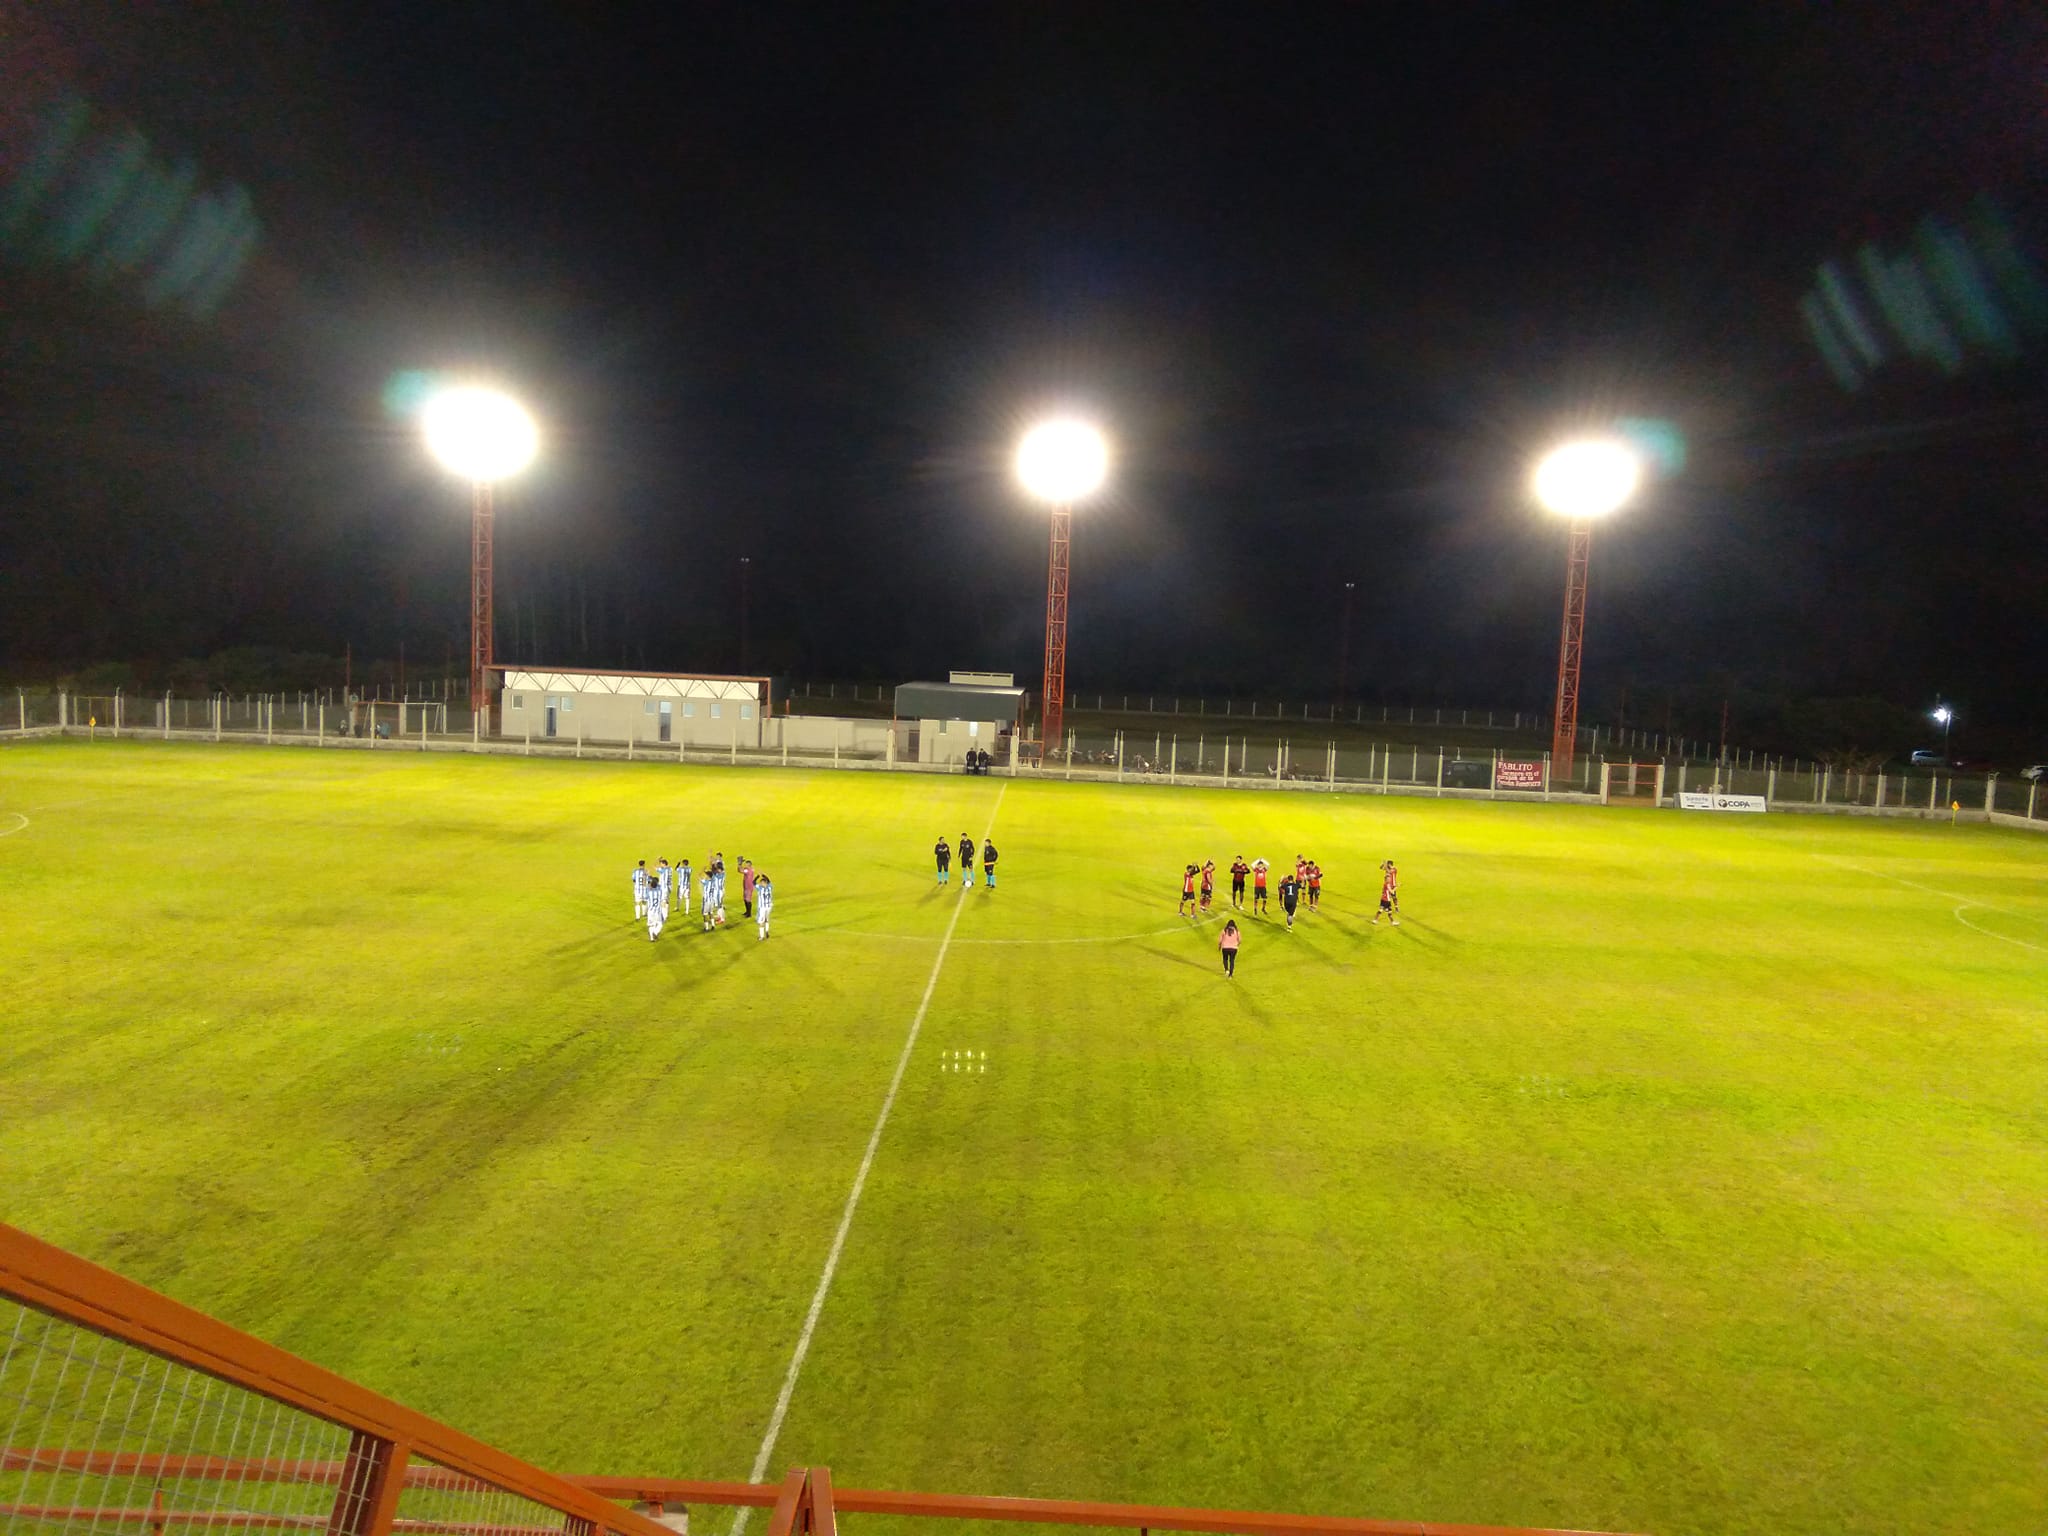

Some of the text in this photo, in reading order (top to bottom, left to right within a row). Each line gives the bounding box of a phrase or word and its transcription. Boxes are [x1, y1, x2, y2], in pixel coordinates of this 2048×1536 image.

[1498, 762, 1533, 771] PABLITO
[1728, 800, 1750, 808] COPA
[1287, 885, 1294, 896] 1
